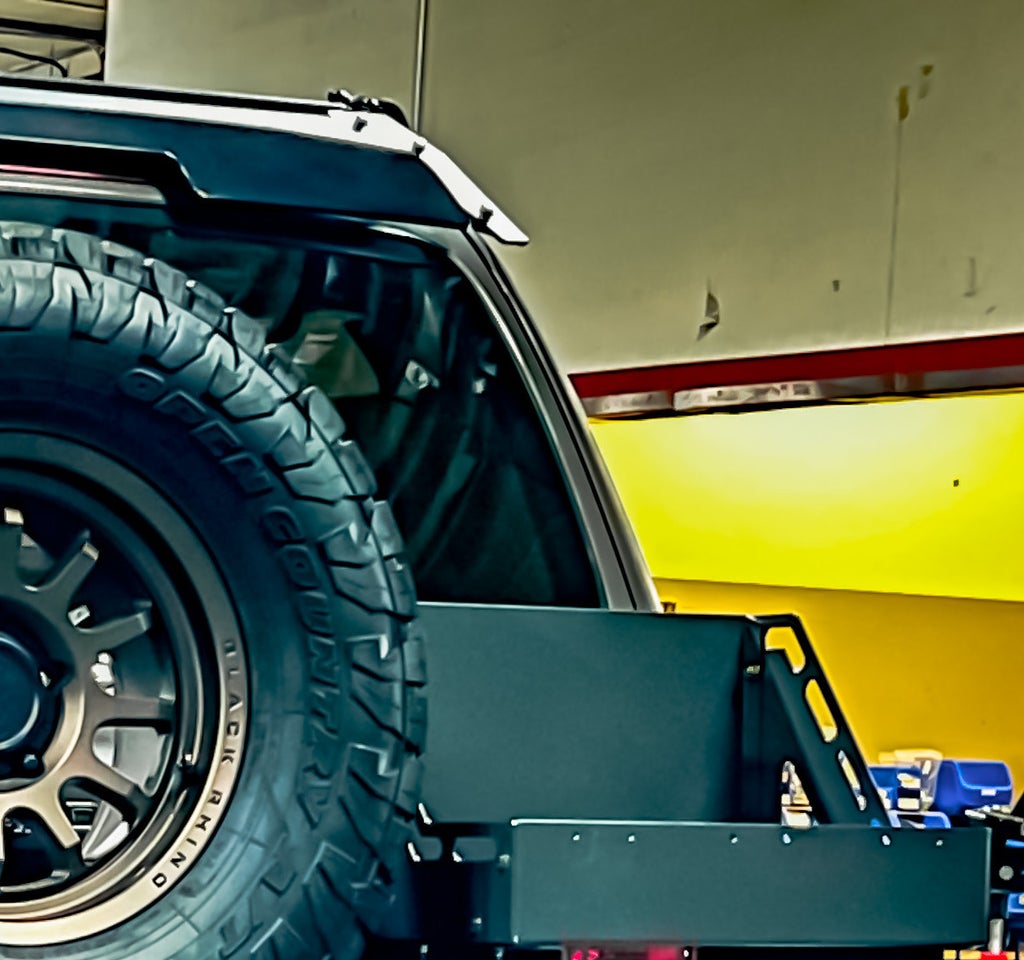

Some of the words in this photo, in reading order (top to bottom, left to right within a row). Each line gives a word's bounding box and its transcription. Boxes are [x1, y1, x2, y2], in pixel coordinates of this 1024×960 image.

[120, 366, 274, 495] OPEN
[265, 507, 338, 829] COUNTRY
[222, 639, 244, 764] BLACK
[151, 789, 224, 888] RHINO
